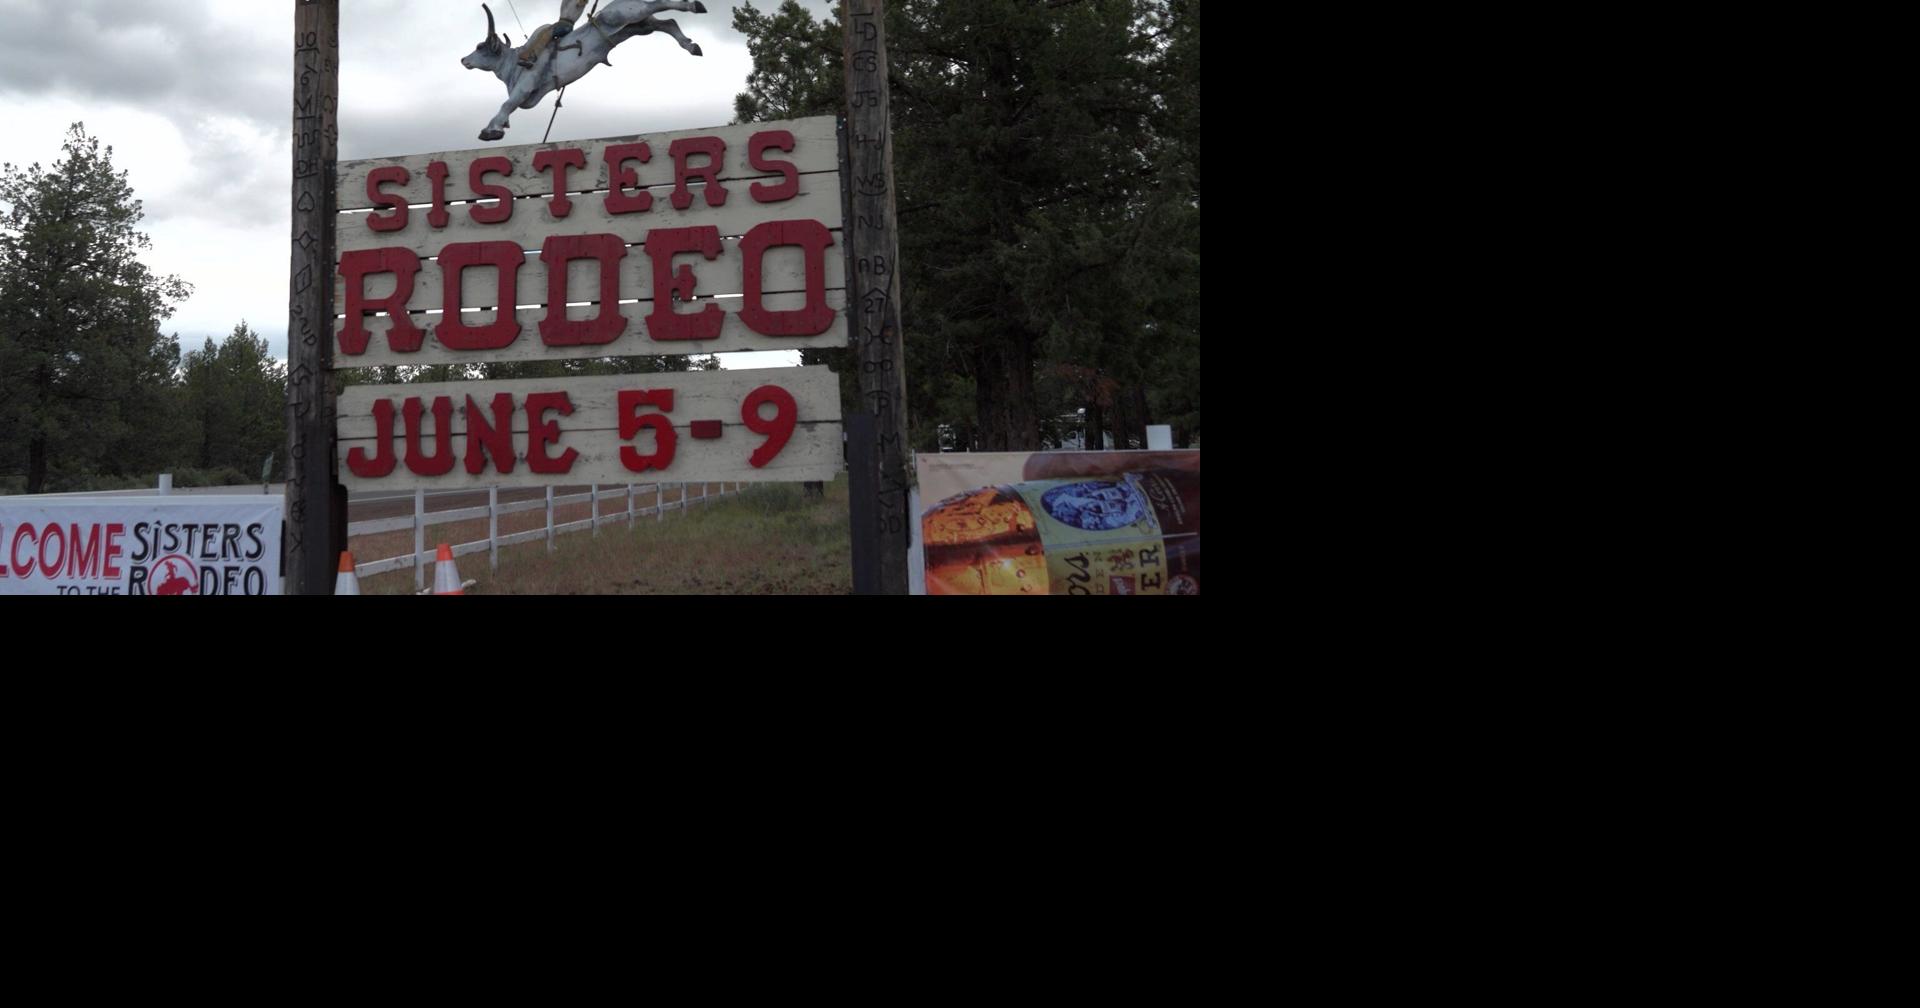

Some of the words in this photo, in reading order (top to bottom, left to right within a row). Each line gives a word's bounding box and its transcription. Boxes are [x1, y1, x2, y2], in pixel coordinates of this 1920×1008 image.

[366, 130, 800, 233] SISTERS
[336, 219, 837, 356] RODEO
[346, 391, 580, 479] JUNE
